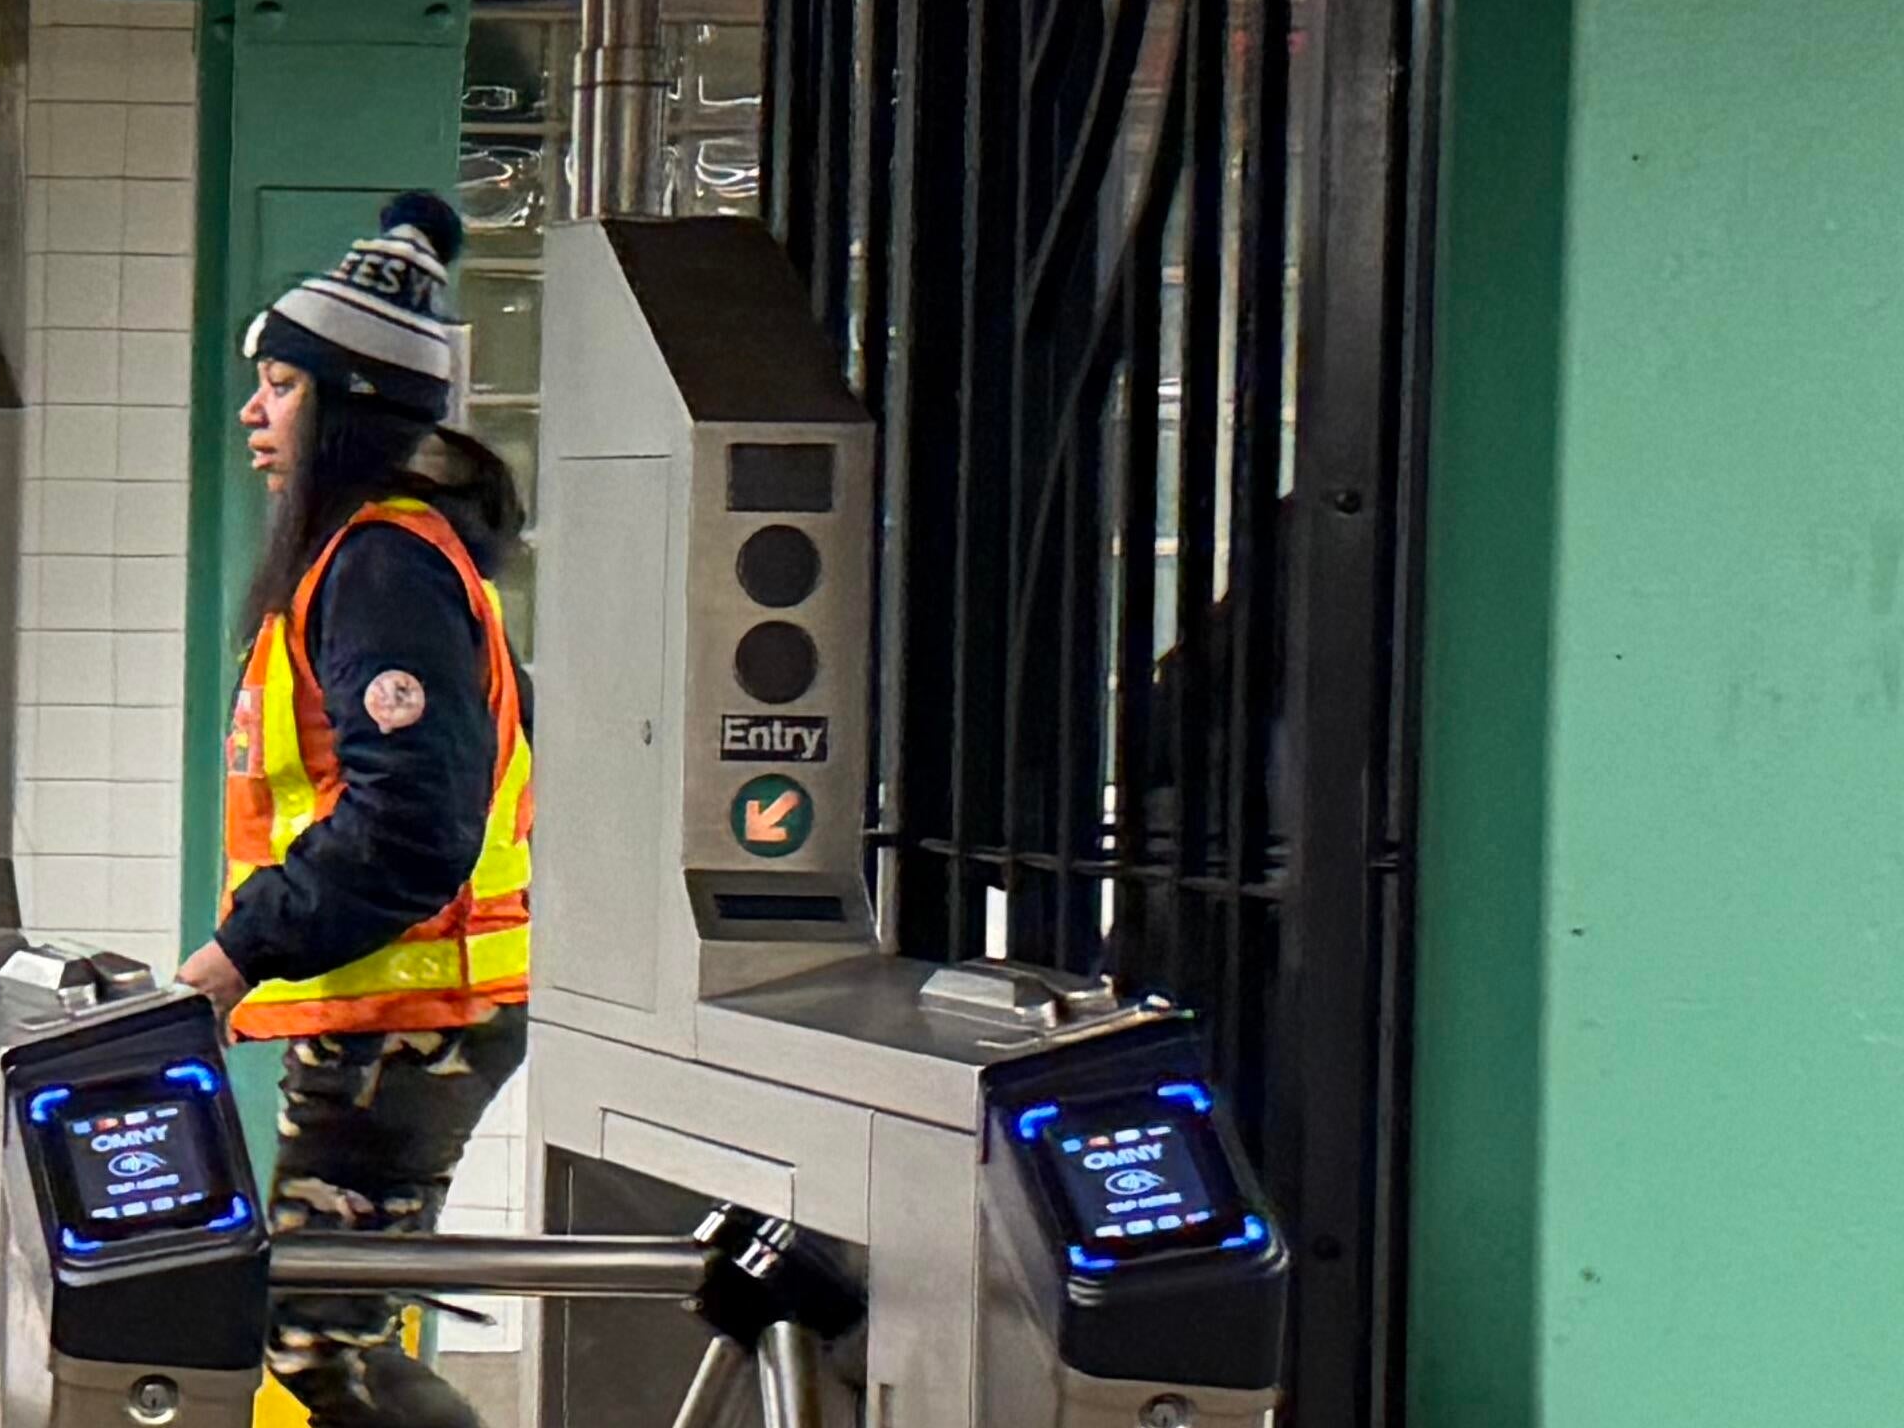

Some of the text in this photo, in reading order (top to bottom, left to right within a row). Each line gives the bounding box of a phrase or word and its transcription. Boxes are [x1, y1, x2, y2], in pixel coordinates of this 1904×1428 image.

[723, 718, 823, 759] Entry
[91, 1124, 169, 1152] OMNY
[1083, 1142, 1162, 1170] OMNY
